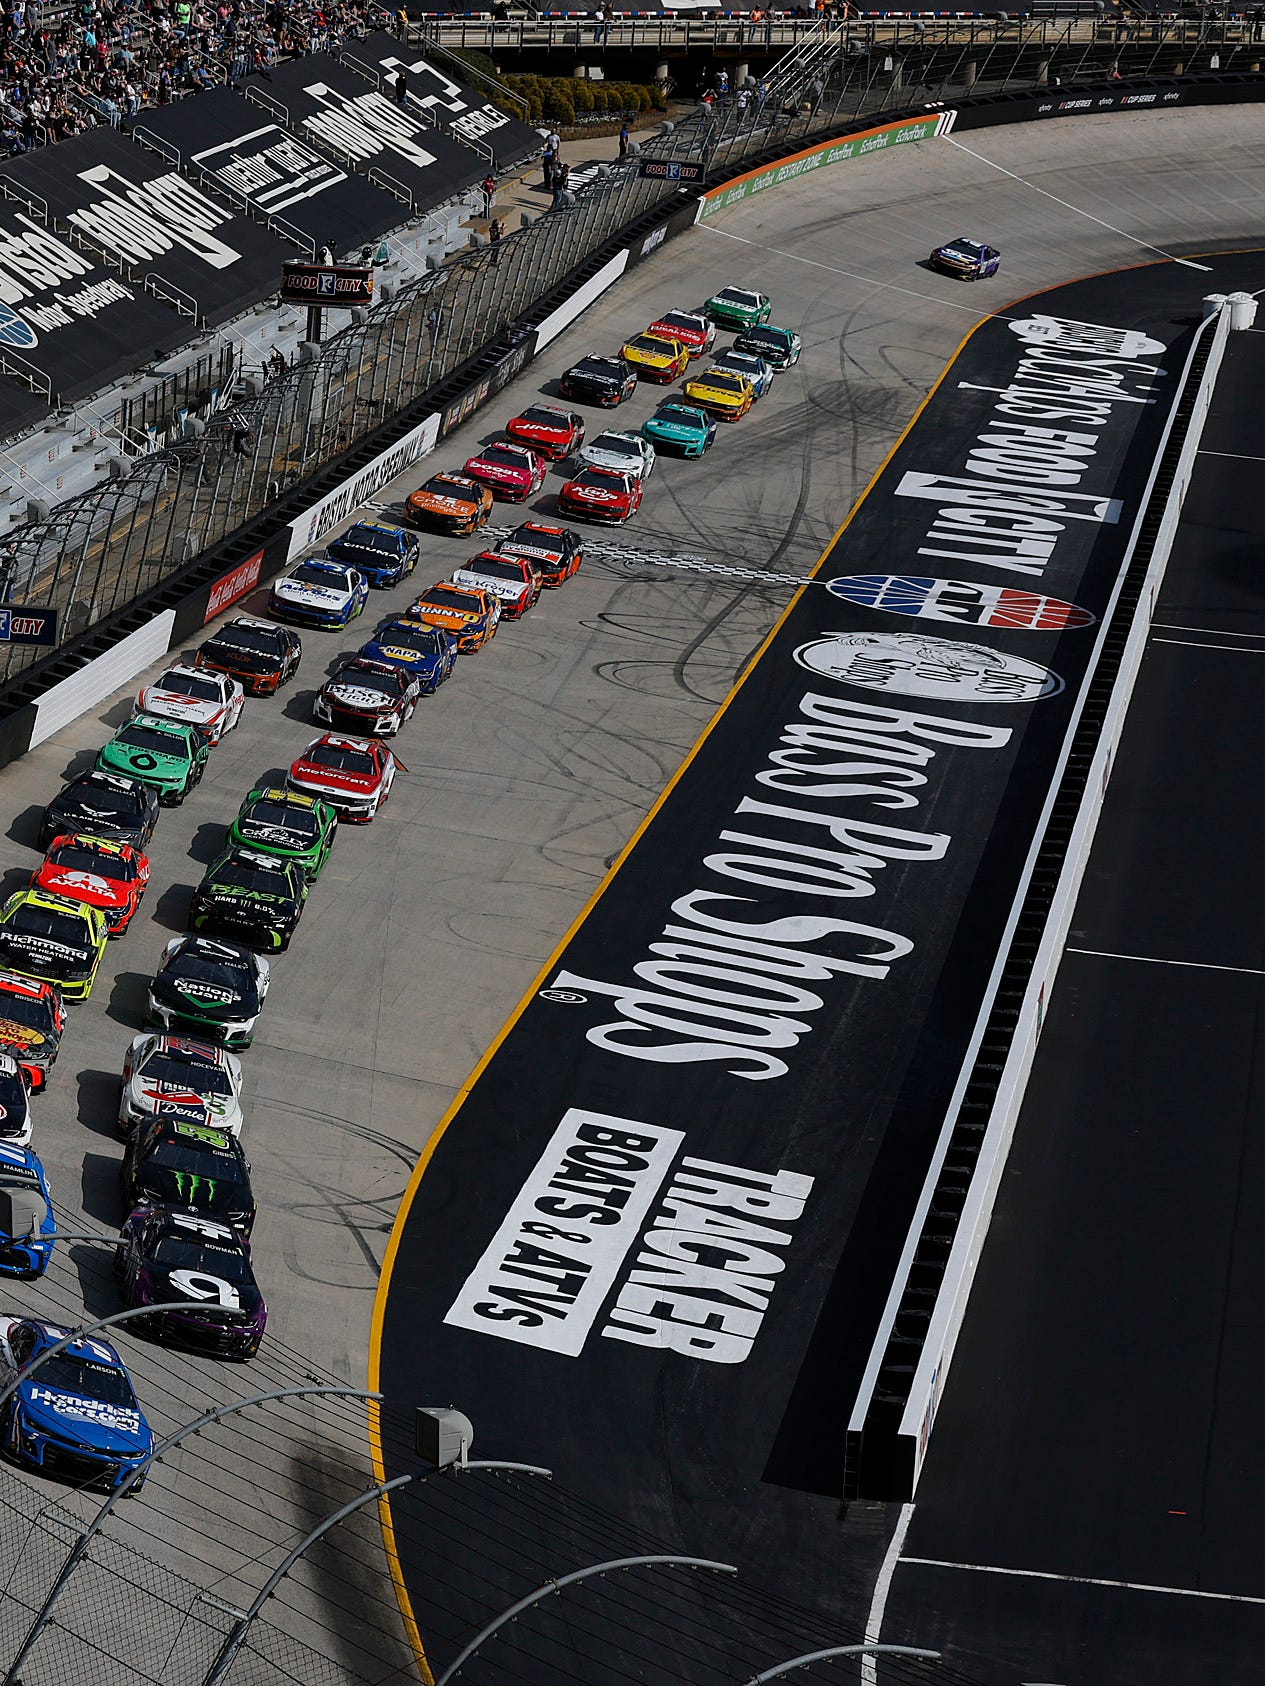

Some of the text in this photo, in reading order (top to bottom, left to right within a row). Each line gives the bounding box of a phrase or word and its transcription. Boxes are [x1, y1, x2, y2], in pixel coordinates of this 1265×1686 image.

[302, 91, 429, 161] FOOD CITY
[448, 103, 512, 140] CHEVROLET
[801, 152, 825, 173] ZONE
[860, 134, 889, 152] EchoPark
[896, 124, 928, 143] EchoPark
[646, 164, 698, 178] FOOD CITY
[66, 172, 235, 265] FOOD CITY
[287, 275, 362, 292] FOOD CITY
[18, 277, 136, 333] Motor Speedway
[379, 434, 420, 487] SPEEDWAY
[414, 496, 469, 513] CHOICE
[917, 420, 1100, 577] FOOD CITY
[476, 581, 519, 597] Kroger
[411, 605, 463, 618] SUNNY
[11, 617, 45, 636] CITY
[386, 646, 418, 658] NAPA
[839, 651, 917, 688] Shops
[915, 661, 980, 683] Pro
[974, 668, 1048, 699] Bass
[328, 684, 397, 707] BUSCH
[297, 767, 370, 786] Motorcraft
[47, 877, 117, 900] AXALTA
[211, 883, 294, 906] BEAST
[550, 691, 1013, 1081] Bass Pro Shops
[0, 932, 88, 961] Richmond
[3, 1164, 33, 1176] HAMLIN
[473, 1121, 660, 1330] BOATS & ATVs
[204, 1243, 238, 1256] BOWMAN
[601, 1155, 816, 1365] TRACKER
[86, 1362, 117, 1376] LARSON
[30, 1387, 140, 1420] Hendrick
